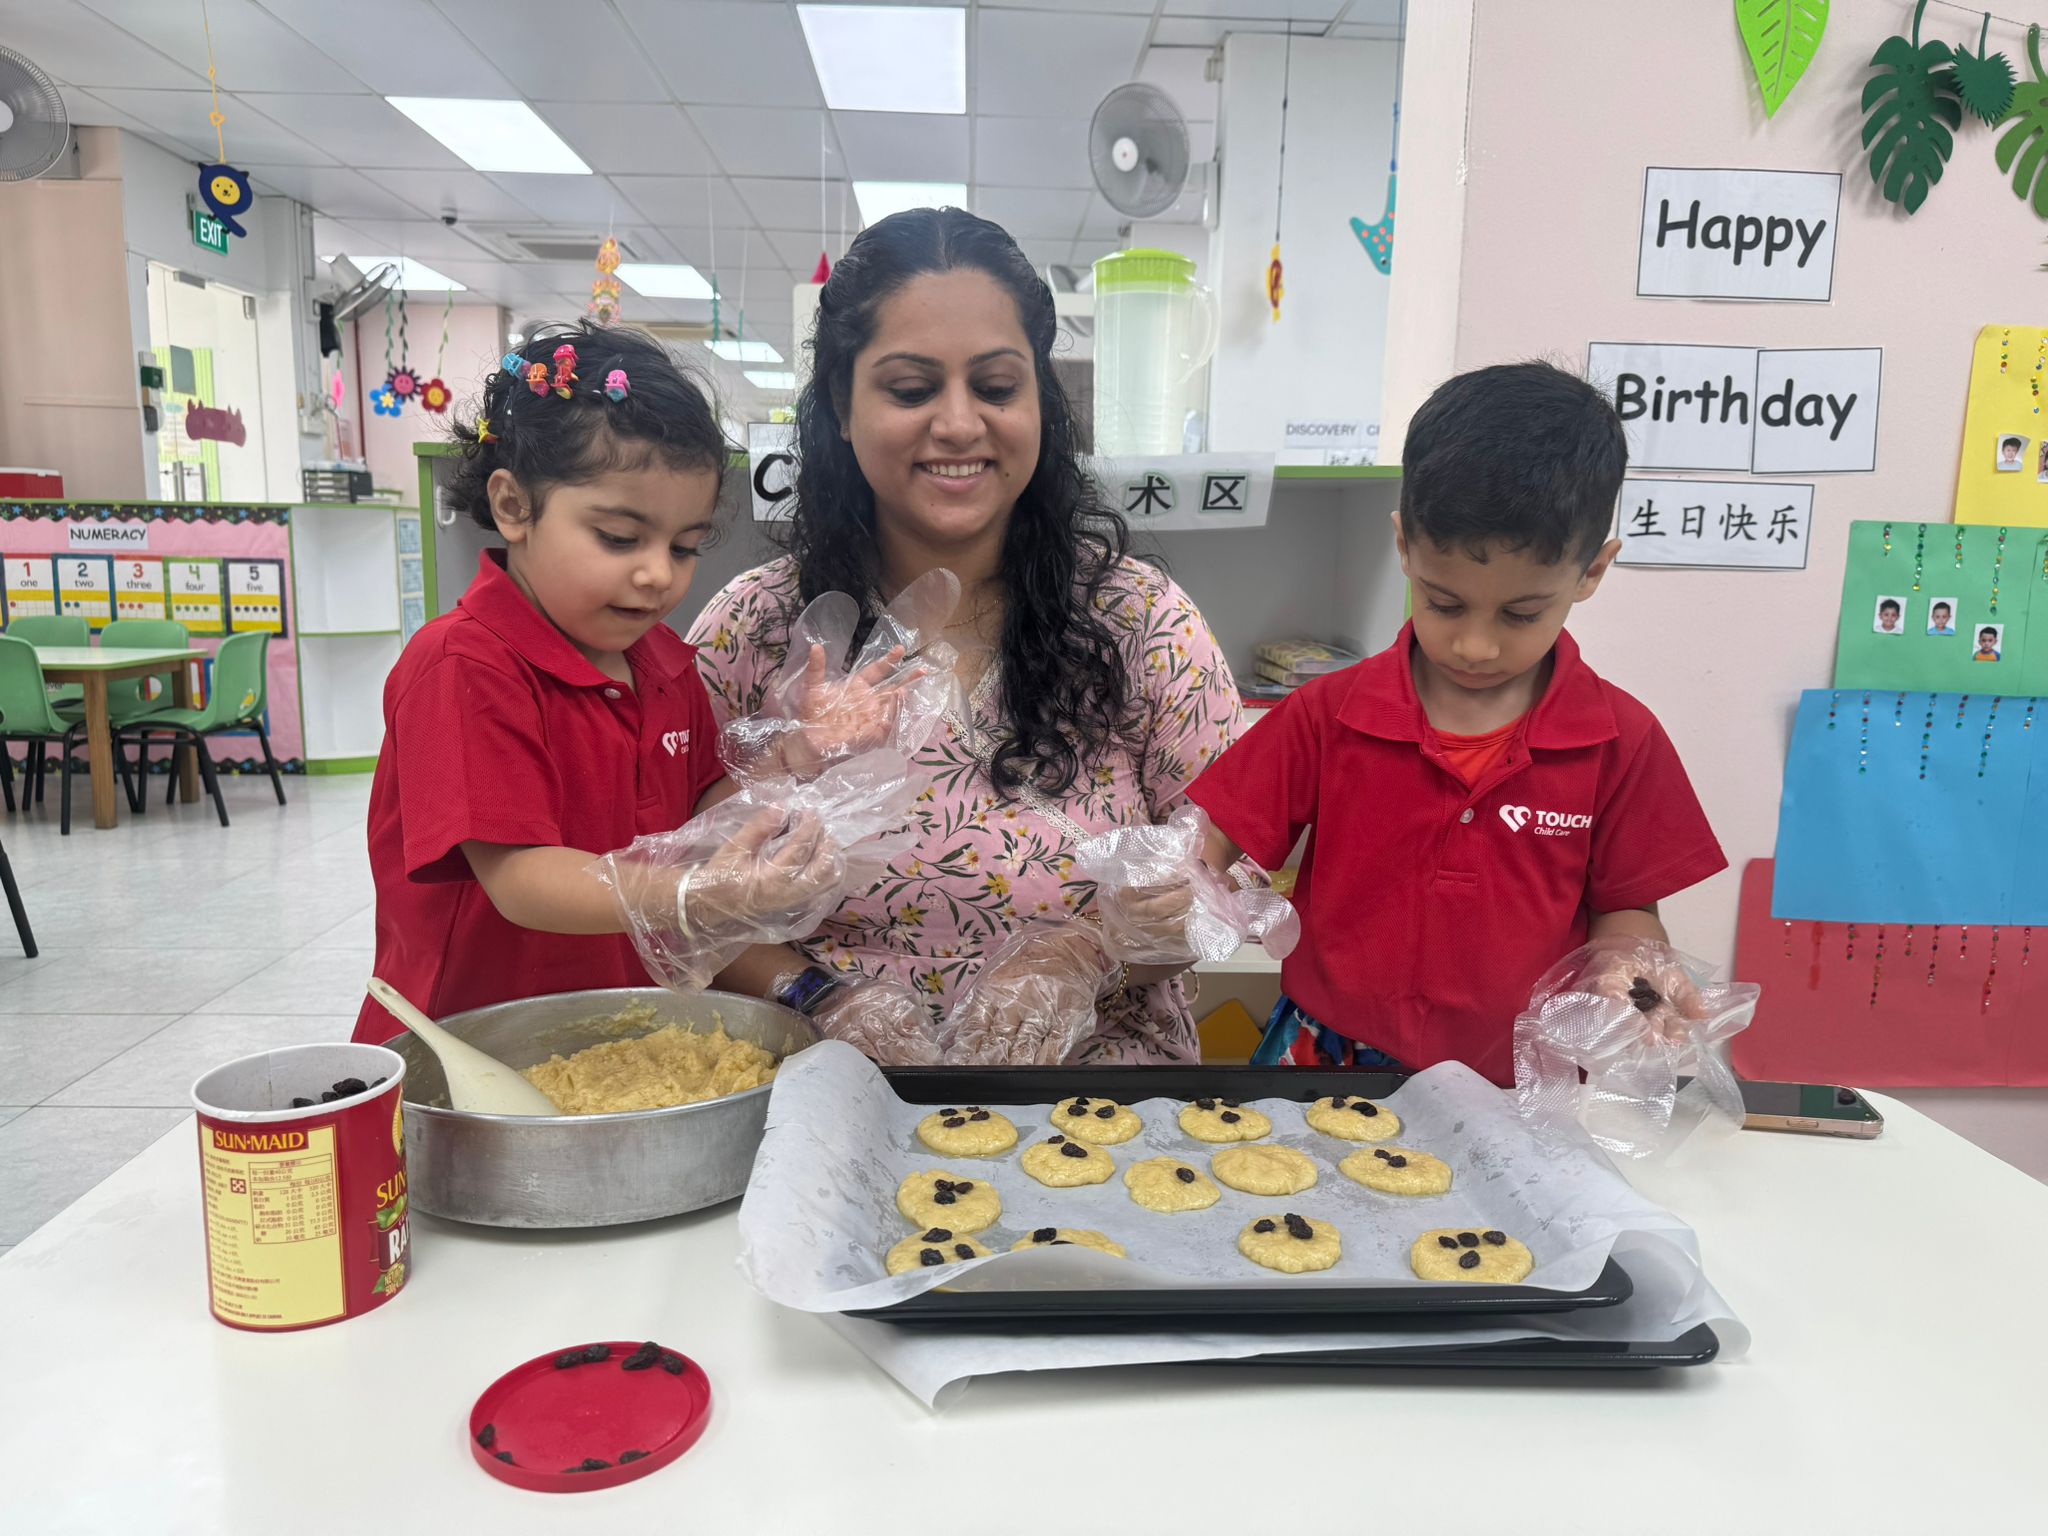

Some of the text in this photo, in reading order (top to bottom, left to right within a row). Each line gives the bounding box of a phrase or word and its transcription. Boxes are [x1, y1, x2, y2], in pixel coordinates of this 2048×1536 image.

[200, 217, 222, 248] EXIT
[1655, 198, 1827, 269] Happy
[1615, 372, 1858, 441] Birthday
[1286, 423, 1357, 437] DISCOVERY
[1626, 498, 1799, 545] 生日快乐
[69, 527, 147, 542] NUMERACY
[23, 561, 31, 577] 1
[77, 562, 89, 578] 2
[132, 562, 145, 579] 3
[188, 564, 201, 581] 4
[248, 565, 260, 581] 5
[20, 579, 38, 588] one
[74, 579, 95, 588] two
[126, 579, 152, 590] three
[185, 581, 206, 591] four
[246, 582, 264, 592] five
[1535, 810, 1592, 828] TOUCH
[1534, 826, 1570, 837] Child Care
